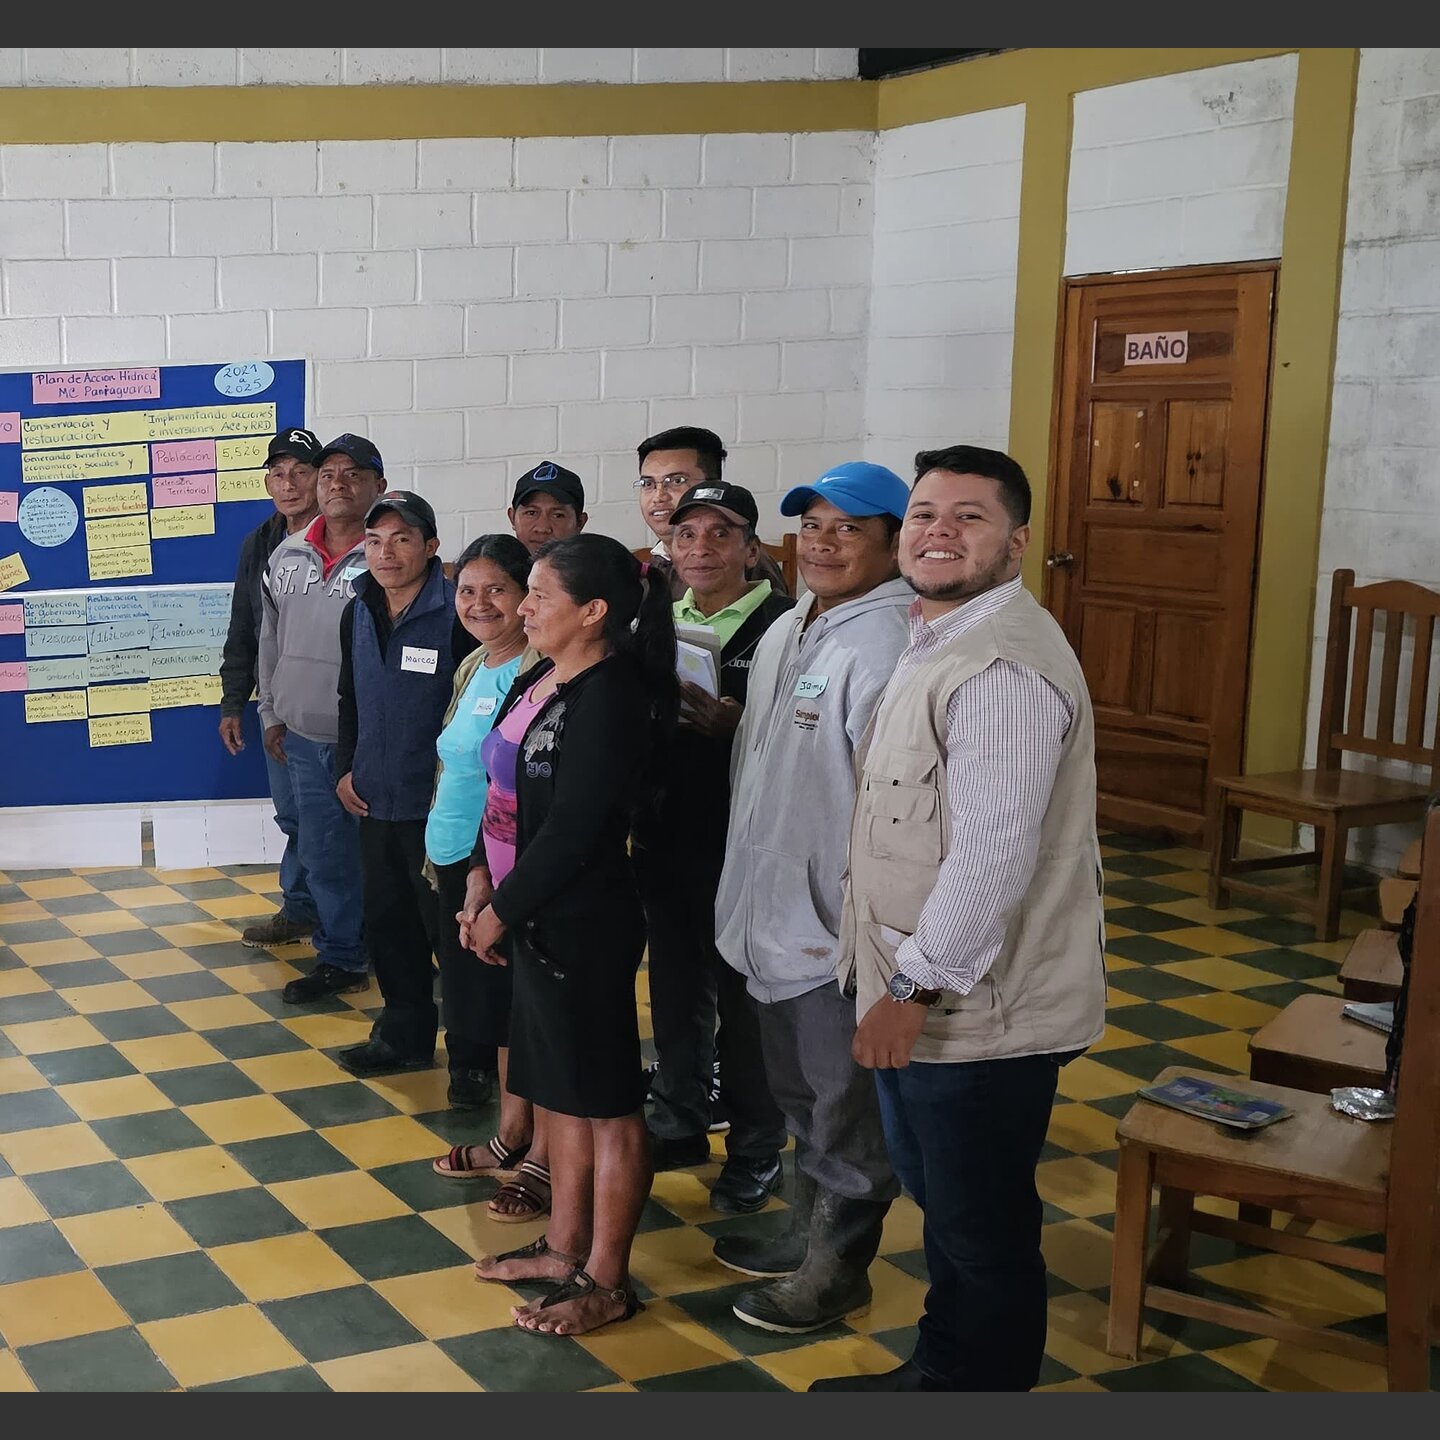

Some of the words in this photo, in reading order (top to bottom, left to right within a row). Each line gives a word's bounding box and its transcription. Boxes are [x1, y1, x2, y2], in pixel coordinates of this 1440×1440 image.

[1128, 336, 1185, 360] BAÑO
[223, 364, 258, 378] 2021
[36, 373, 64, 385] Plan
[68, 374, 81, 384] de
[225, 378, 262, 394] 2025
[58, 387, 79, 399] MC
[84, 384, 153, 399] Paniaguara
[148, 410, 228, 426] Implementando
[231, 409, 273, 419] acciones
[159, 425, 215, 437] inversiones
[155, 448, 211, 464] Población
[222, 445, 260, 460] 5,526
[167, 484, 210, 496] Territorial
[405, 655, 436, 665] Marcos
[800, 681, 824, 690] Jaime
